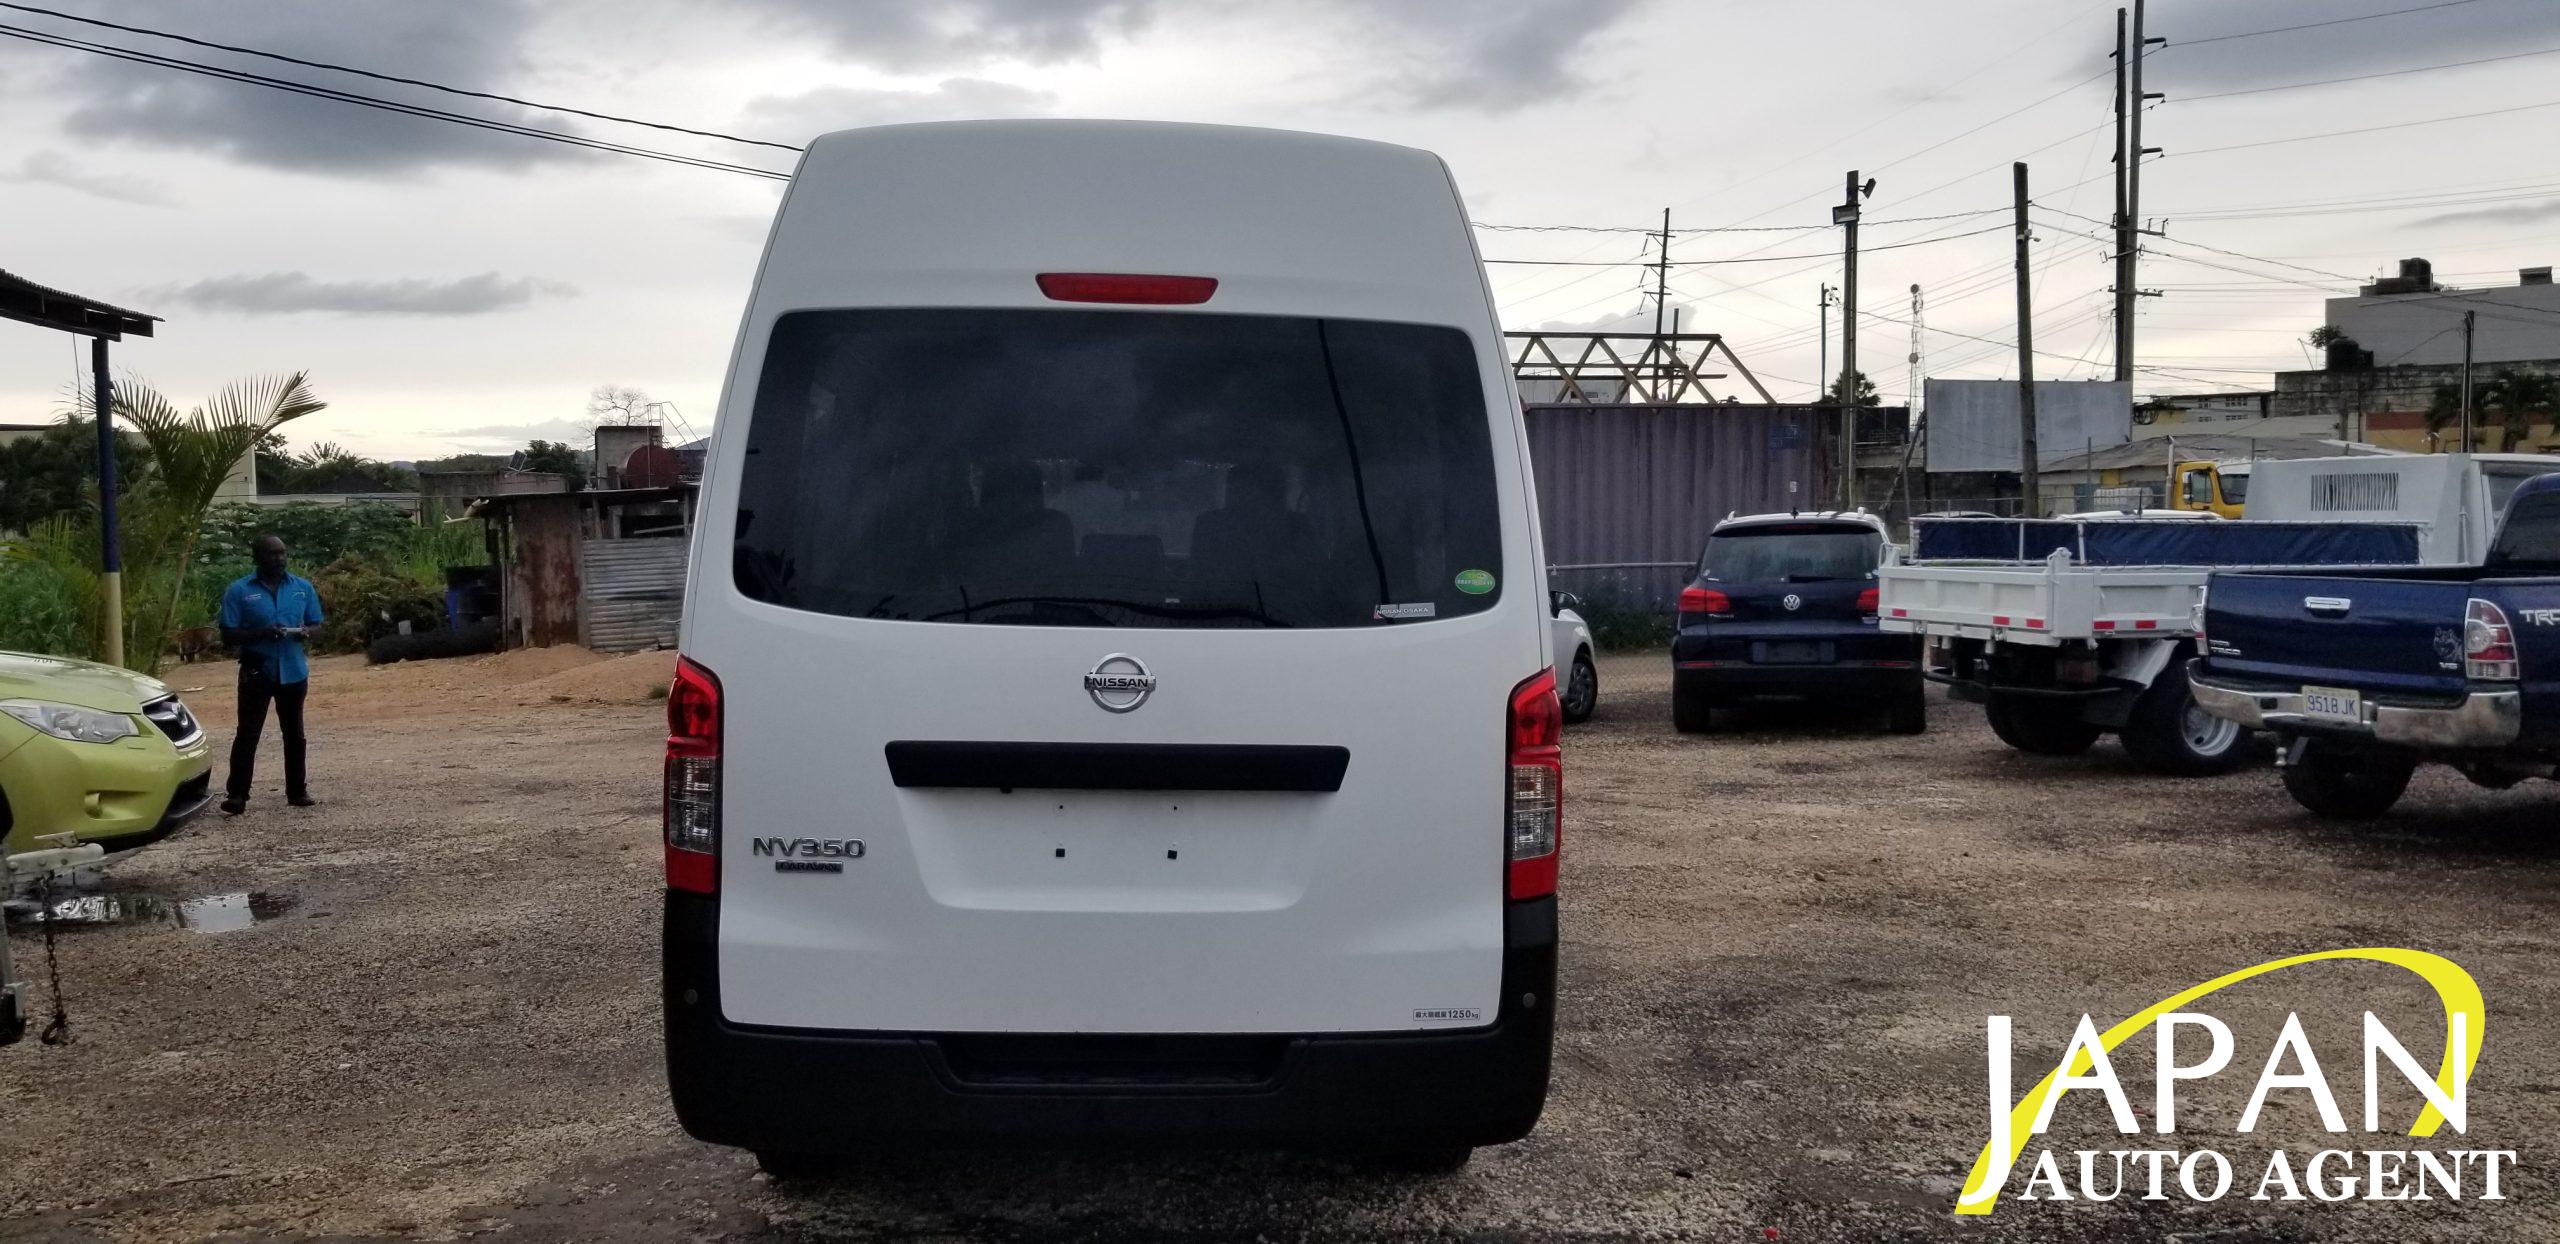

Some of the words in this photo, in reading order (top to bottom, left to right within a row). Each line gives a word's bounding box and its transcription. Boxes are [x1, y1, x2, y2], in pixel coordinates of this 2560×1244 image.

[1092, 677, 1148, 688] NISSAN
[2308, 694, 2338, 713] 9518
[2342, 699, 2357, 715] JK
[753, 836, 866, 857] NV350
